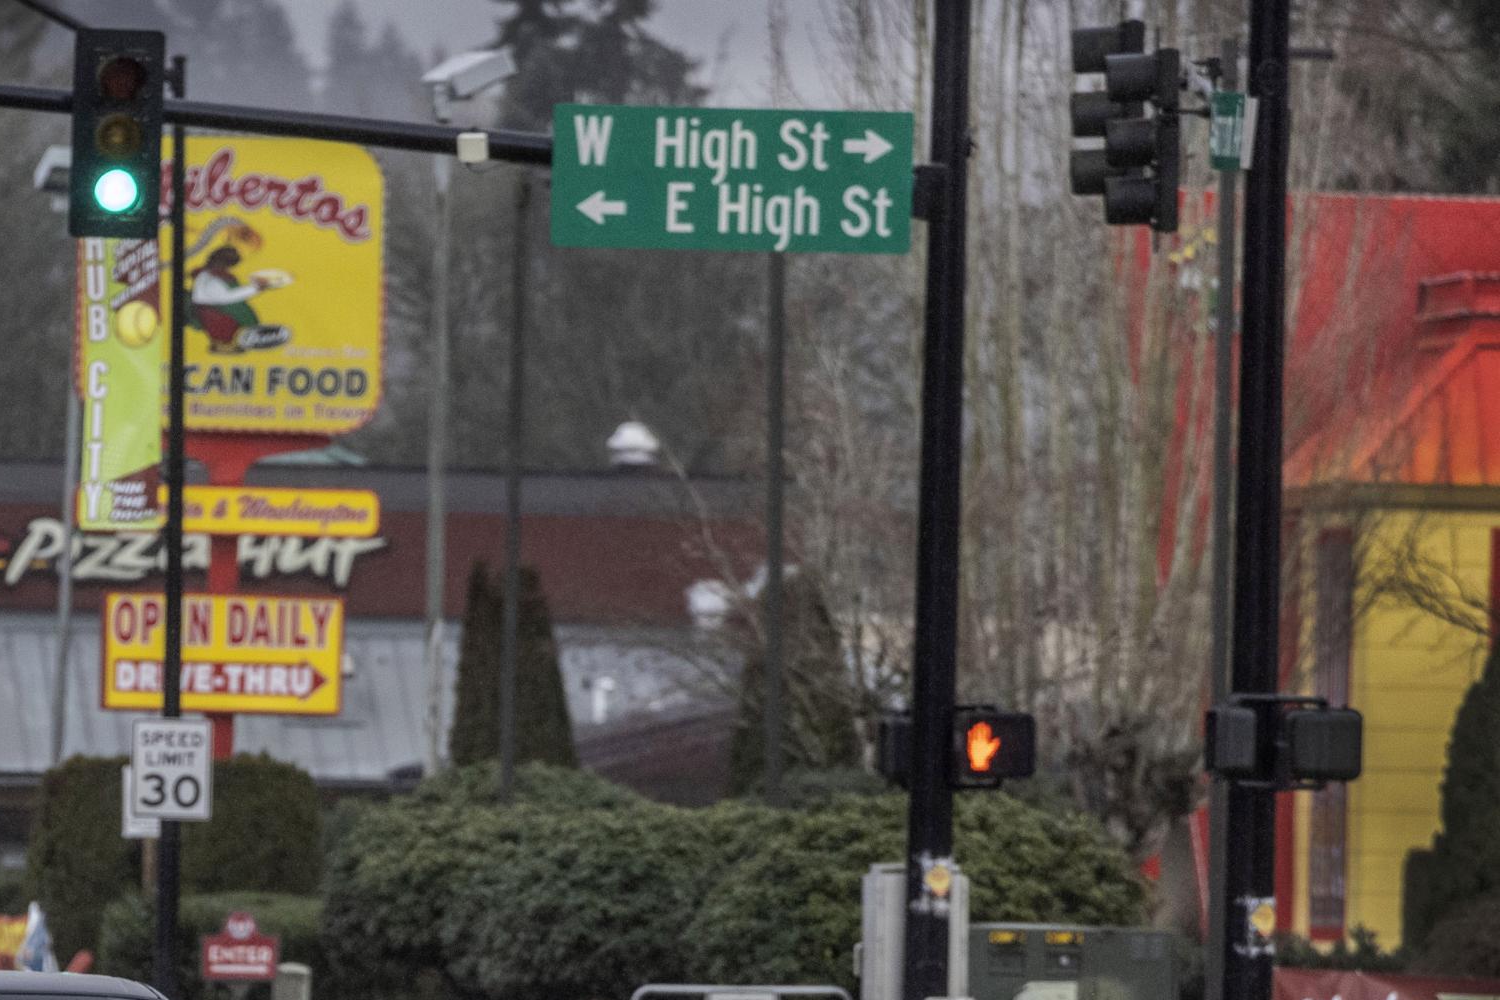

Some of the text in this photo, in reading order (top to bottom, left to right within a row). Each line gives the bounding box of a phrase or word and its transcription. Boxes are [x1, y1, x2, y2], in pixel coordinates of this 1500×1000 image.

[574, 114, 831, 185] W High St
[666, 181, 894, 252] E High St
[266, 365, 368, 397] FOOD
[85, 361, 108, 521] CITY
[113, 600, 334, 650] OPN DAILY
[141, 730, 204, 748] SPEED
[144, 751, 196, 768] LIMIT
[140, 773, 201, 808] 30
